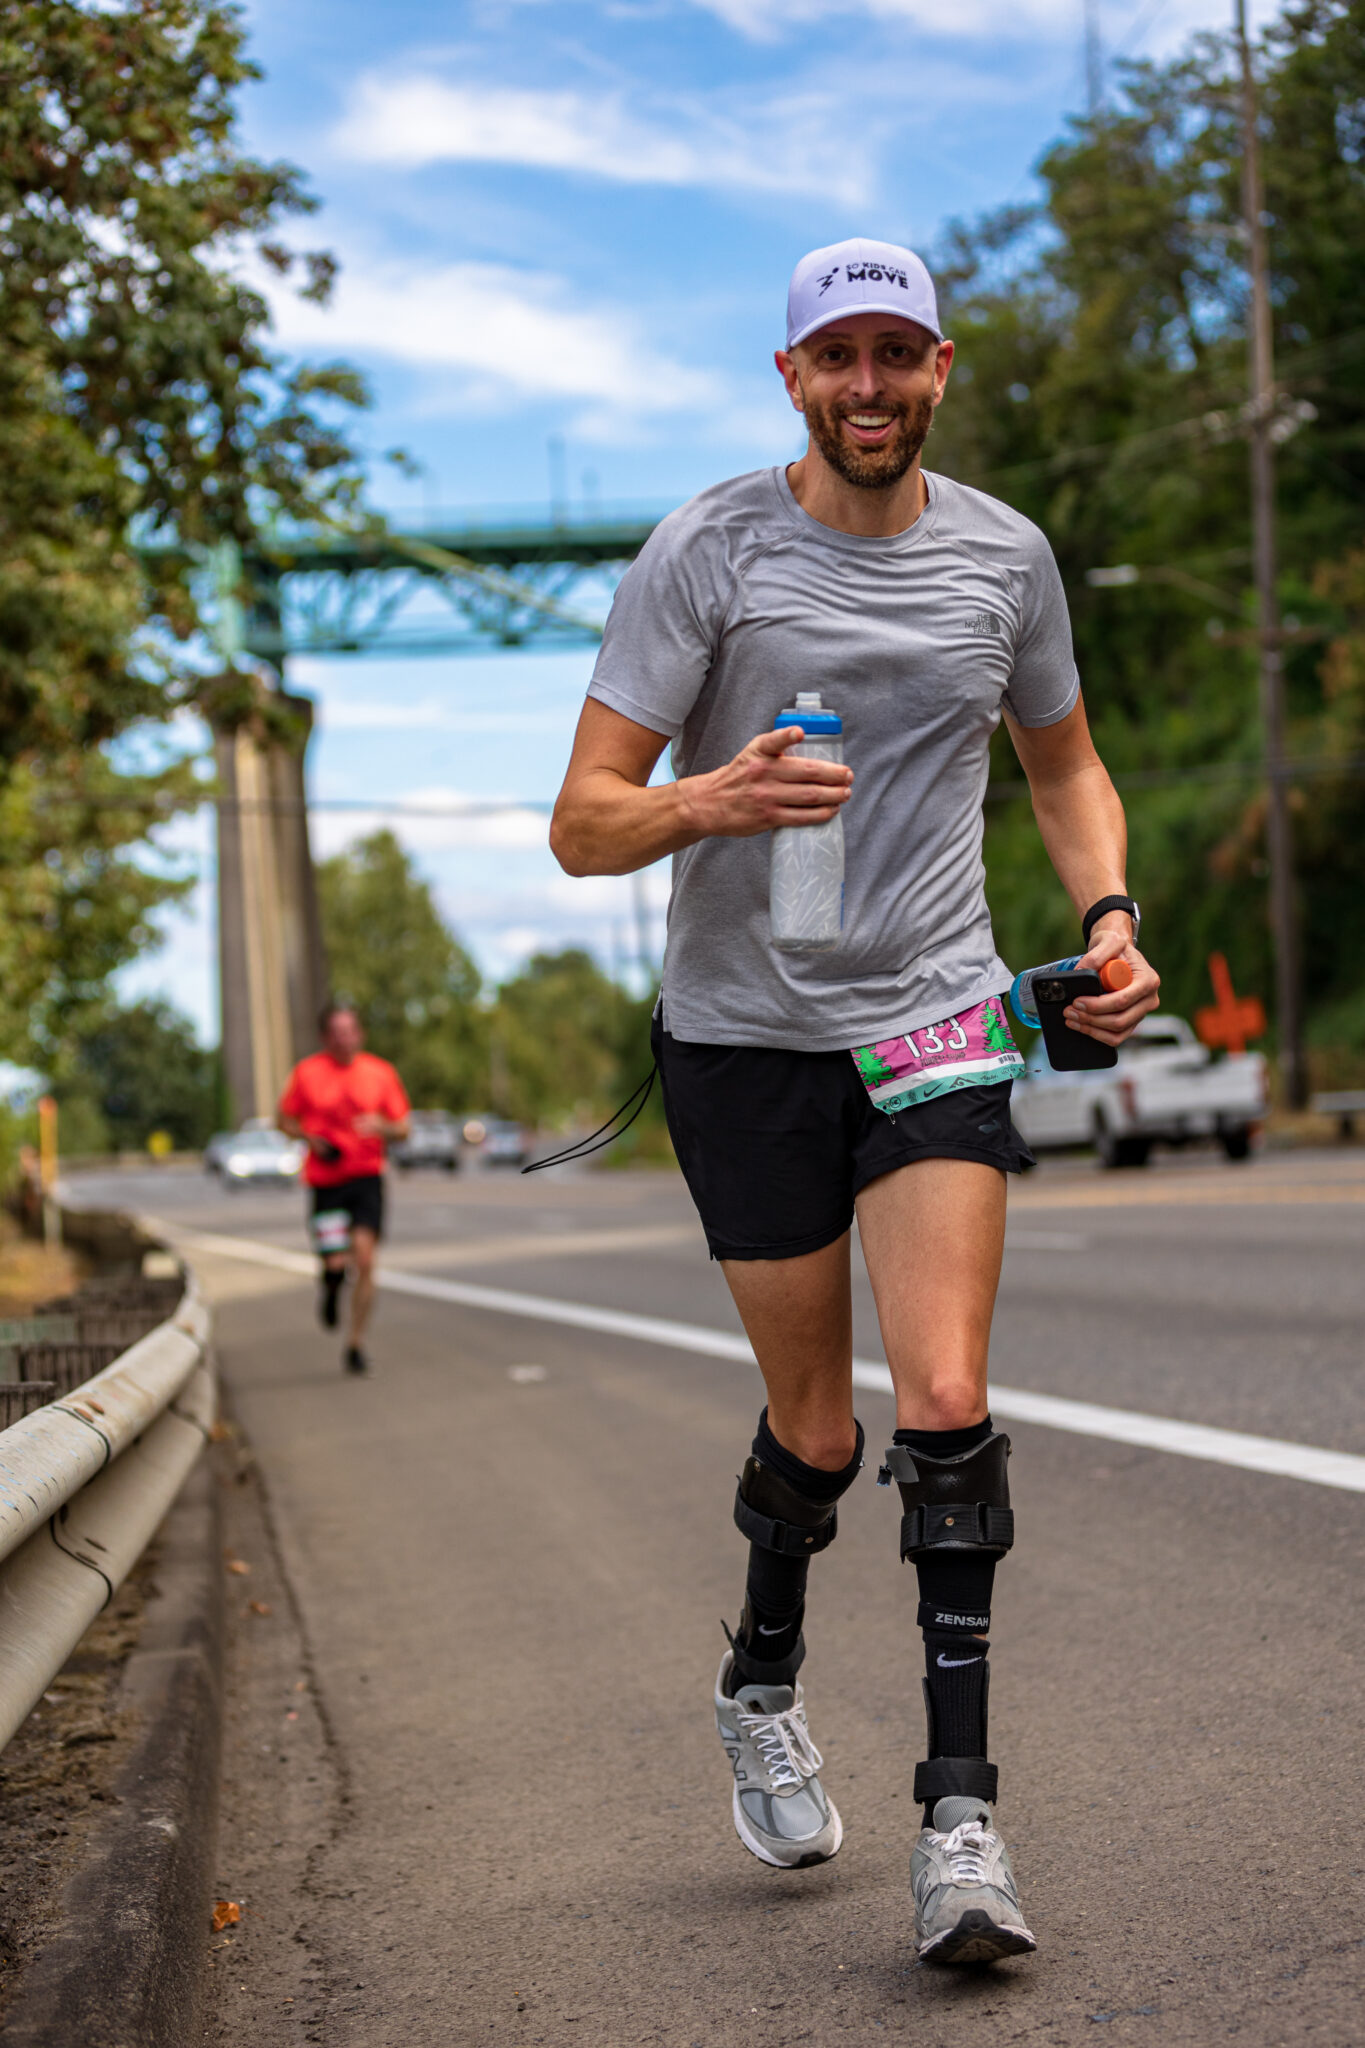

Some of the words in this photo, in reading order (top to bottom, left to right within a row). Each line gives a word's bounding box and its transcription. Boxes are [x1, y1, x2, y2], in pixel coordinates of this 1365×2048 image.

[862, 262, 886, 270] KIDS
[889, 266, 906, 276] CAN
[847, 268, 909, 290] MOVE
[964, 620, 991, 629] NORTH
[976, 614, 991, 622] THE
[903, 1016, 968, 1058] 133
[935, 1612, 989, 1628] ZENSAH
